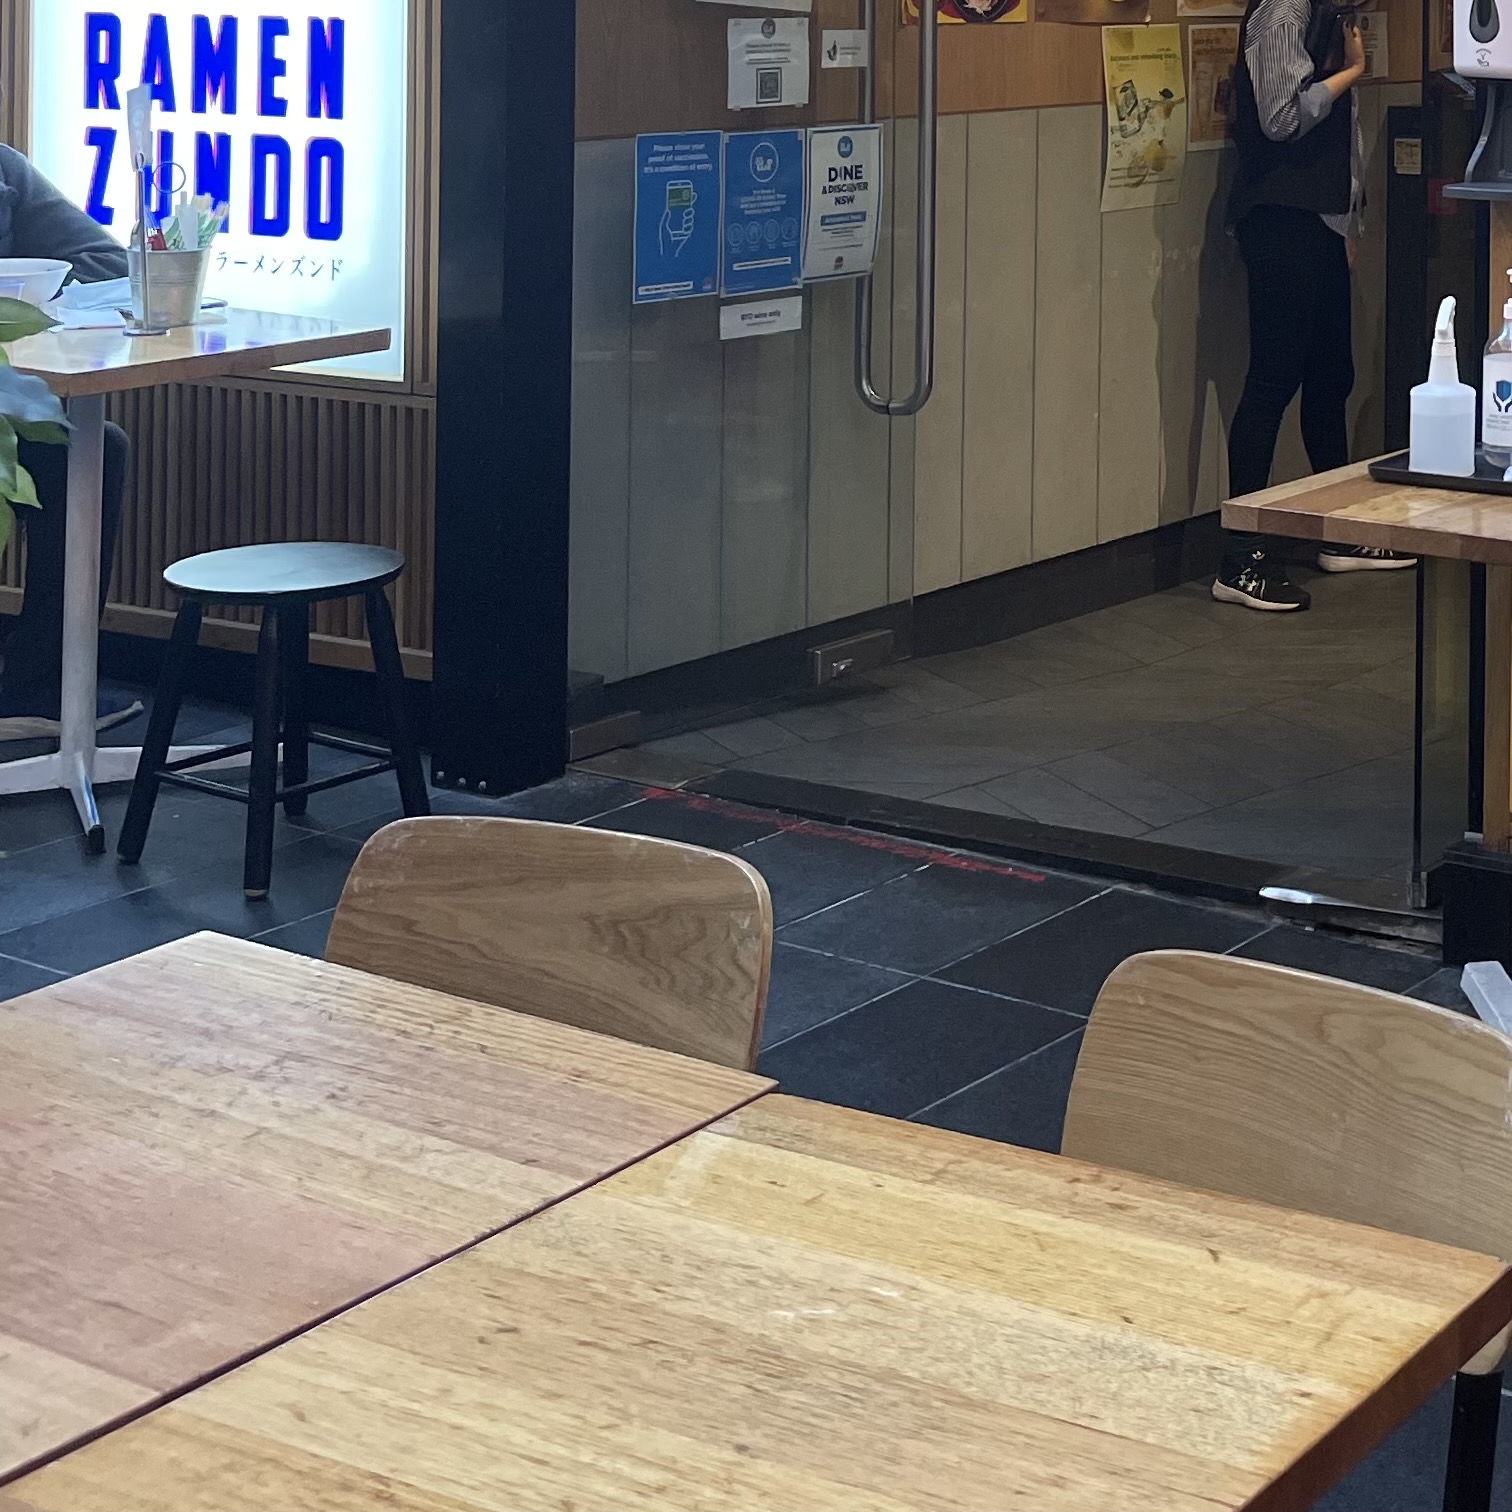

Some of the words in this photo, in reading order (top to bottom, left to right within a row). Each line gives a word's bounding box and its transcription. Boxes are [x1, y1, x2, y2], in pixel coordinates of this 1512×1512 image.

[83, 11, 345, 120] RAMEN
[83, 125, 346, 241] ZUNDO
[828, 164, 863, 182] DINE
[834, 194, 856, 206] NSW
[215, 249, 345, 281] ラーメンズンド
